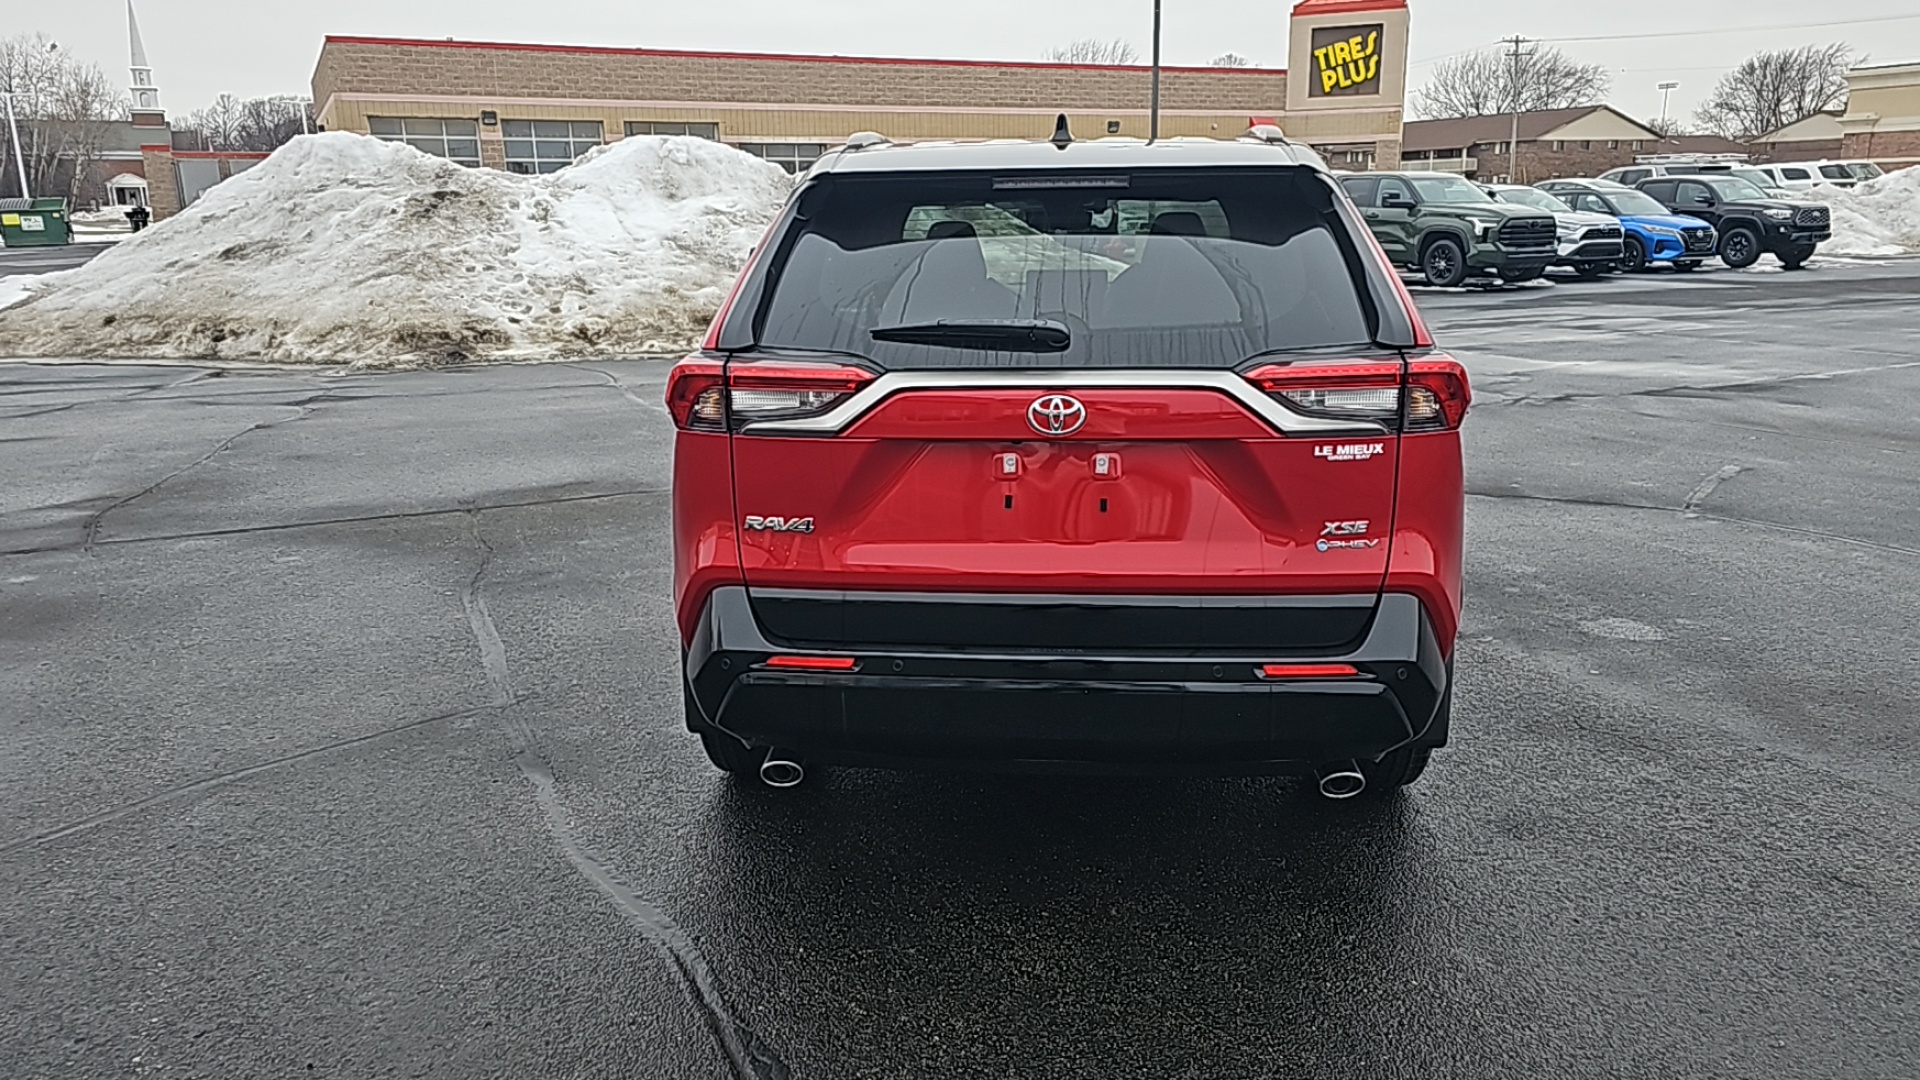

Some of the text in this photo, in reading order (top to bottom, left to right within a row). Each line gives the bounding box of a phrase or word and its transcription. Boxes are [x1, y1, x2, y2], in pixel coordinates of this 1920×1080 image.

[1314, 30, 1378, 70] TIRES
[1321, 54, 1379, 93] PLUS
[1314, 443, 1384, 456] LE MIEUX
[744, 515, 815, 533] RAV4
[1320, 520, 1370, 535] XSE
[1327, 538, 1380, 549] PHEV
